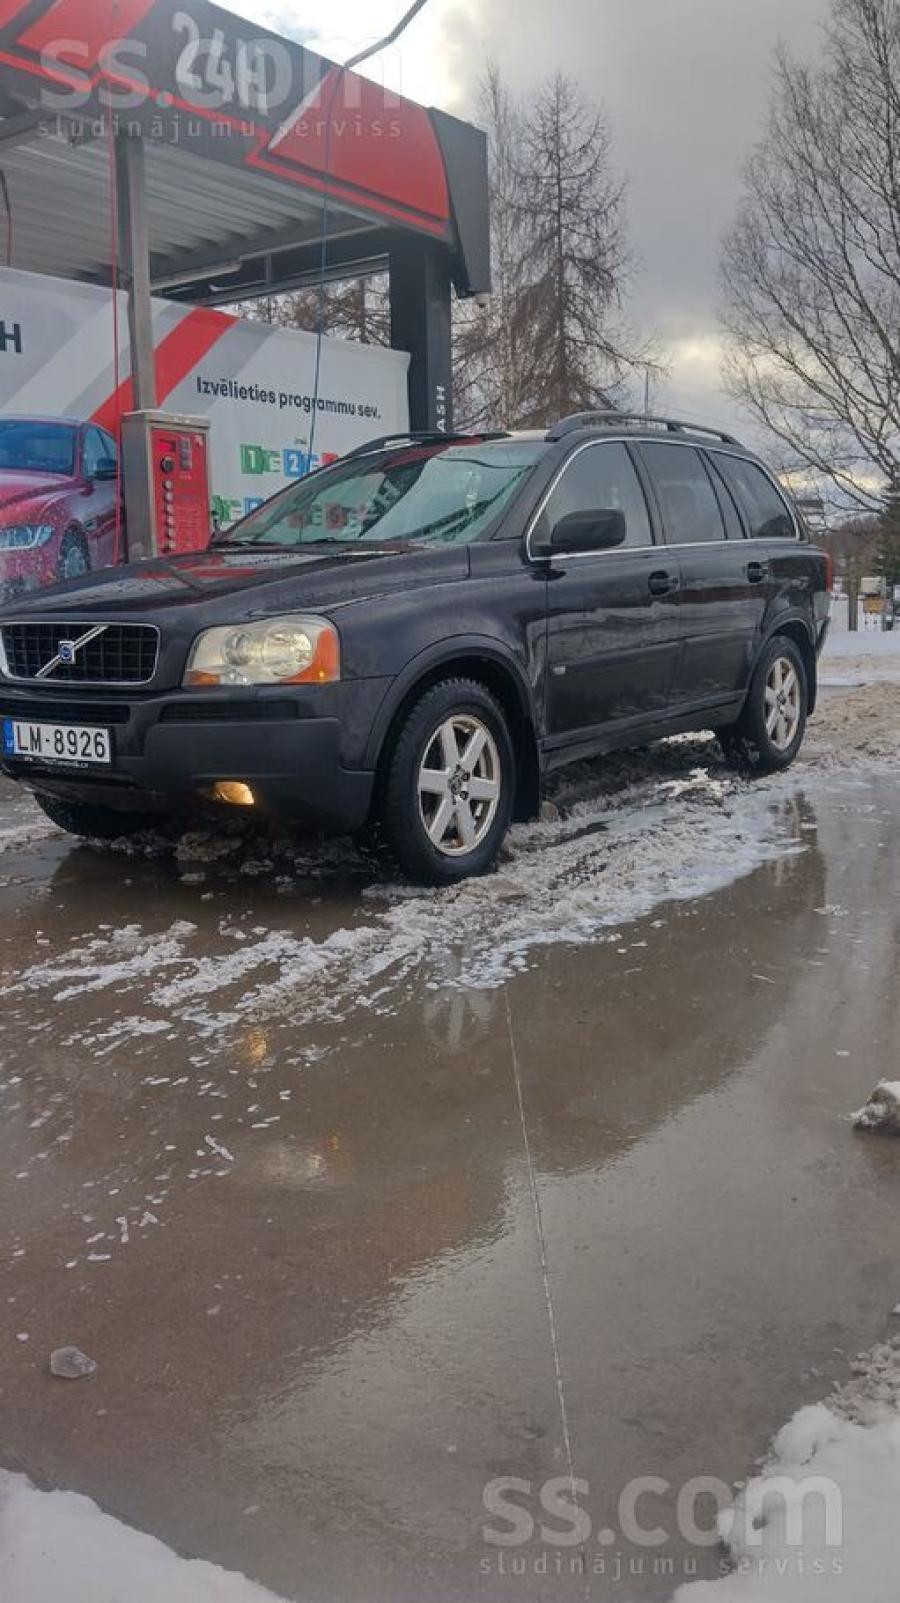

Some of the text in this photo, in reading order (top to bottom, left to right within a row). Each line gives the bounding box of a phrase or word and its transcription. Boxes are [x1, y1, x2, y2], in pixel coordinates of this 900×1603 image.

[171, 11, 269, 116] 24H
[196, 376, 381, 419] Izvēlieties programmu sev.
[17, 725, 105, 758] LM-8926
